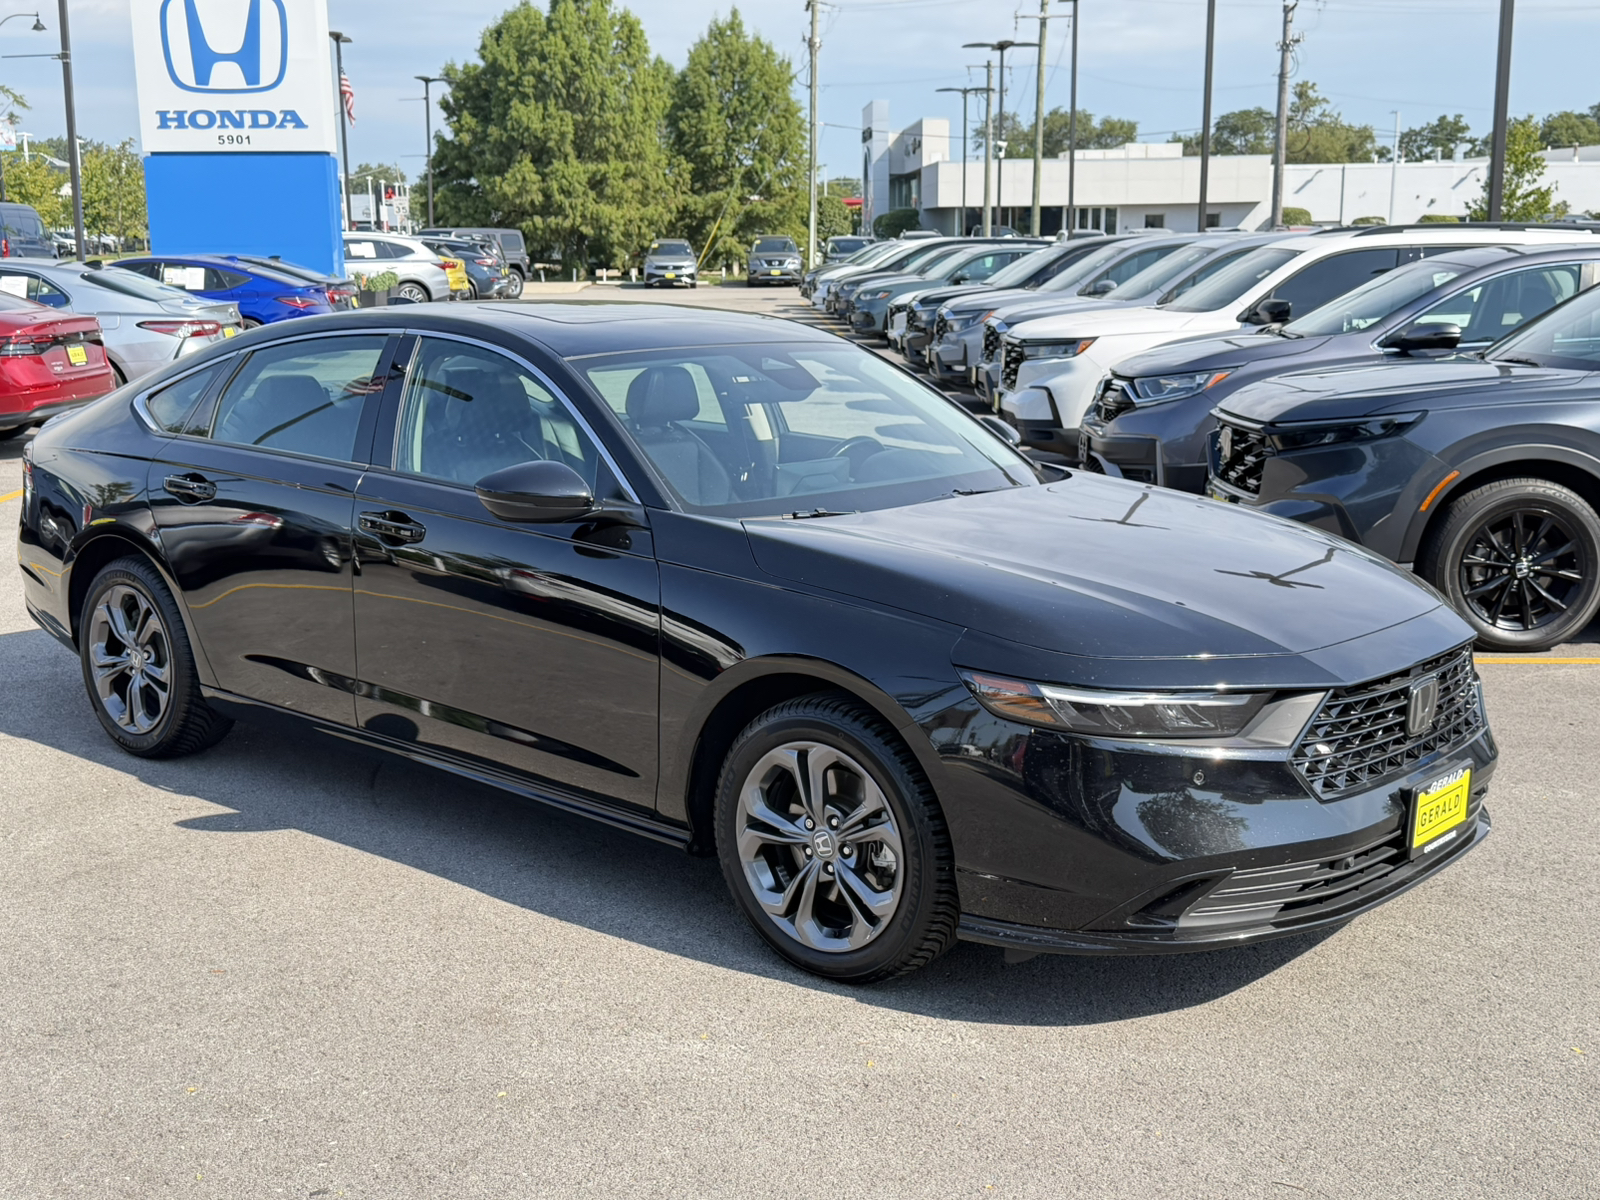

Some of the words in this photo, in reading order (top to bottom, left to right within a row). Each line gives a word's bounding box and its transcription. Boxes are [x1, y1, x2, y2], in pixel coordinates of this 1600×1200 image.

[155, 109, 309, 130] HONDA
[217, 134, 251, 145] 5901
[395, 206, 408, 214] 35
[1430, 768, 1464, 792] GERALD
[1420, 794, 1460, 827] GERALD
